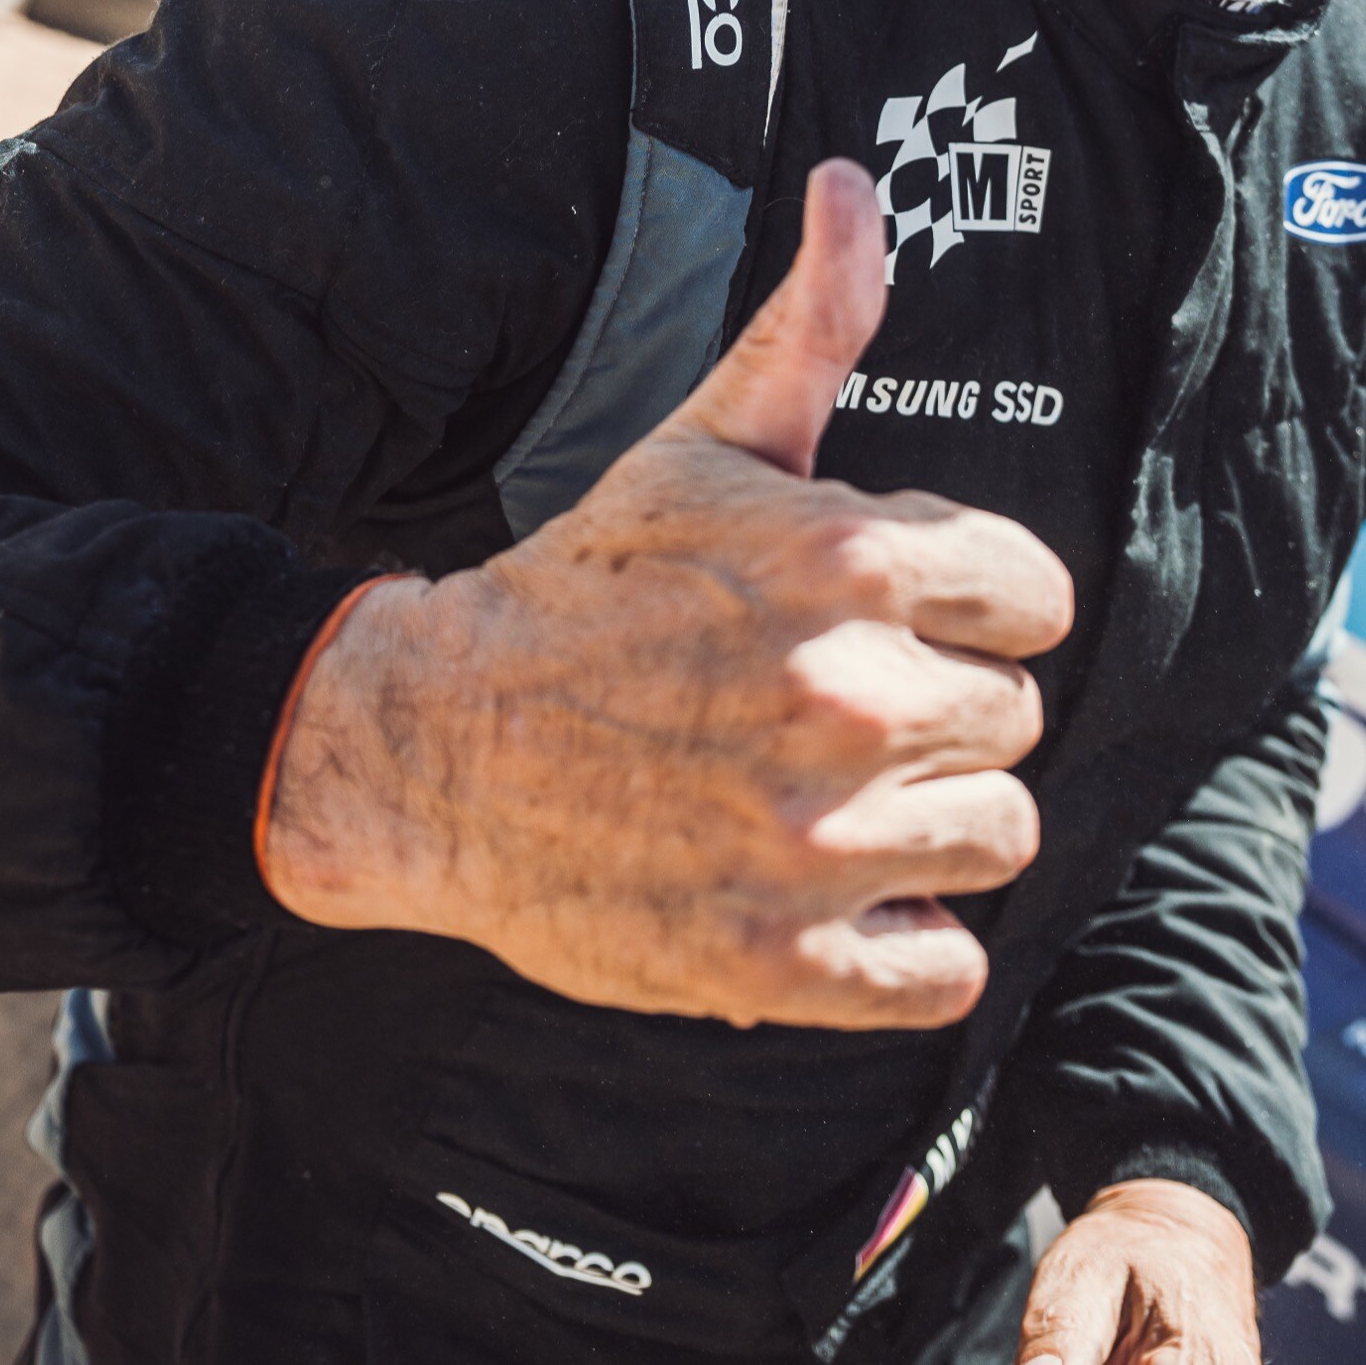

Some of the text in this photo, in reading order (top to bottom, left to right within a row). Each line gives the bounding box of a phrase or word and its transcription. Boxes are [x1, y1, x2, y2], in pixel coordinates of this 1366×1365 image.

[955, 152, 1045, 225] M SPORT
[835, 371, 1064, 427] MSUNG SSD
